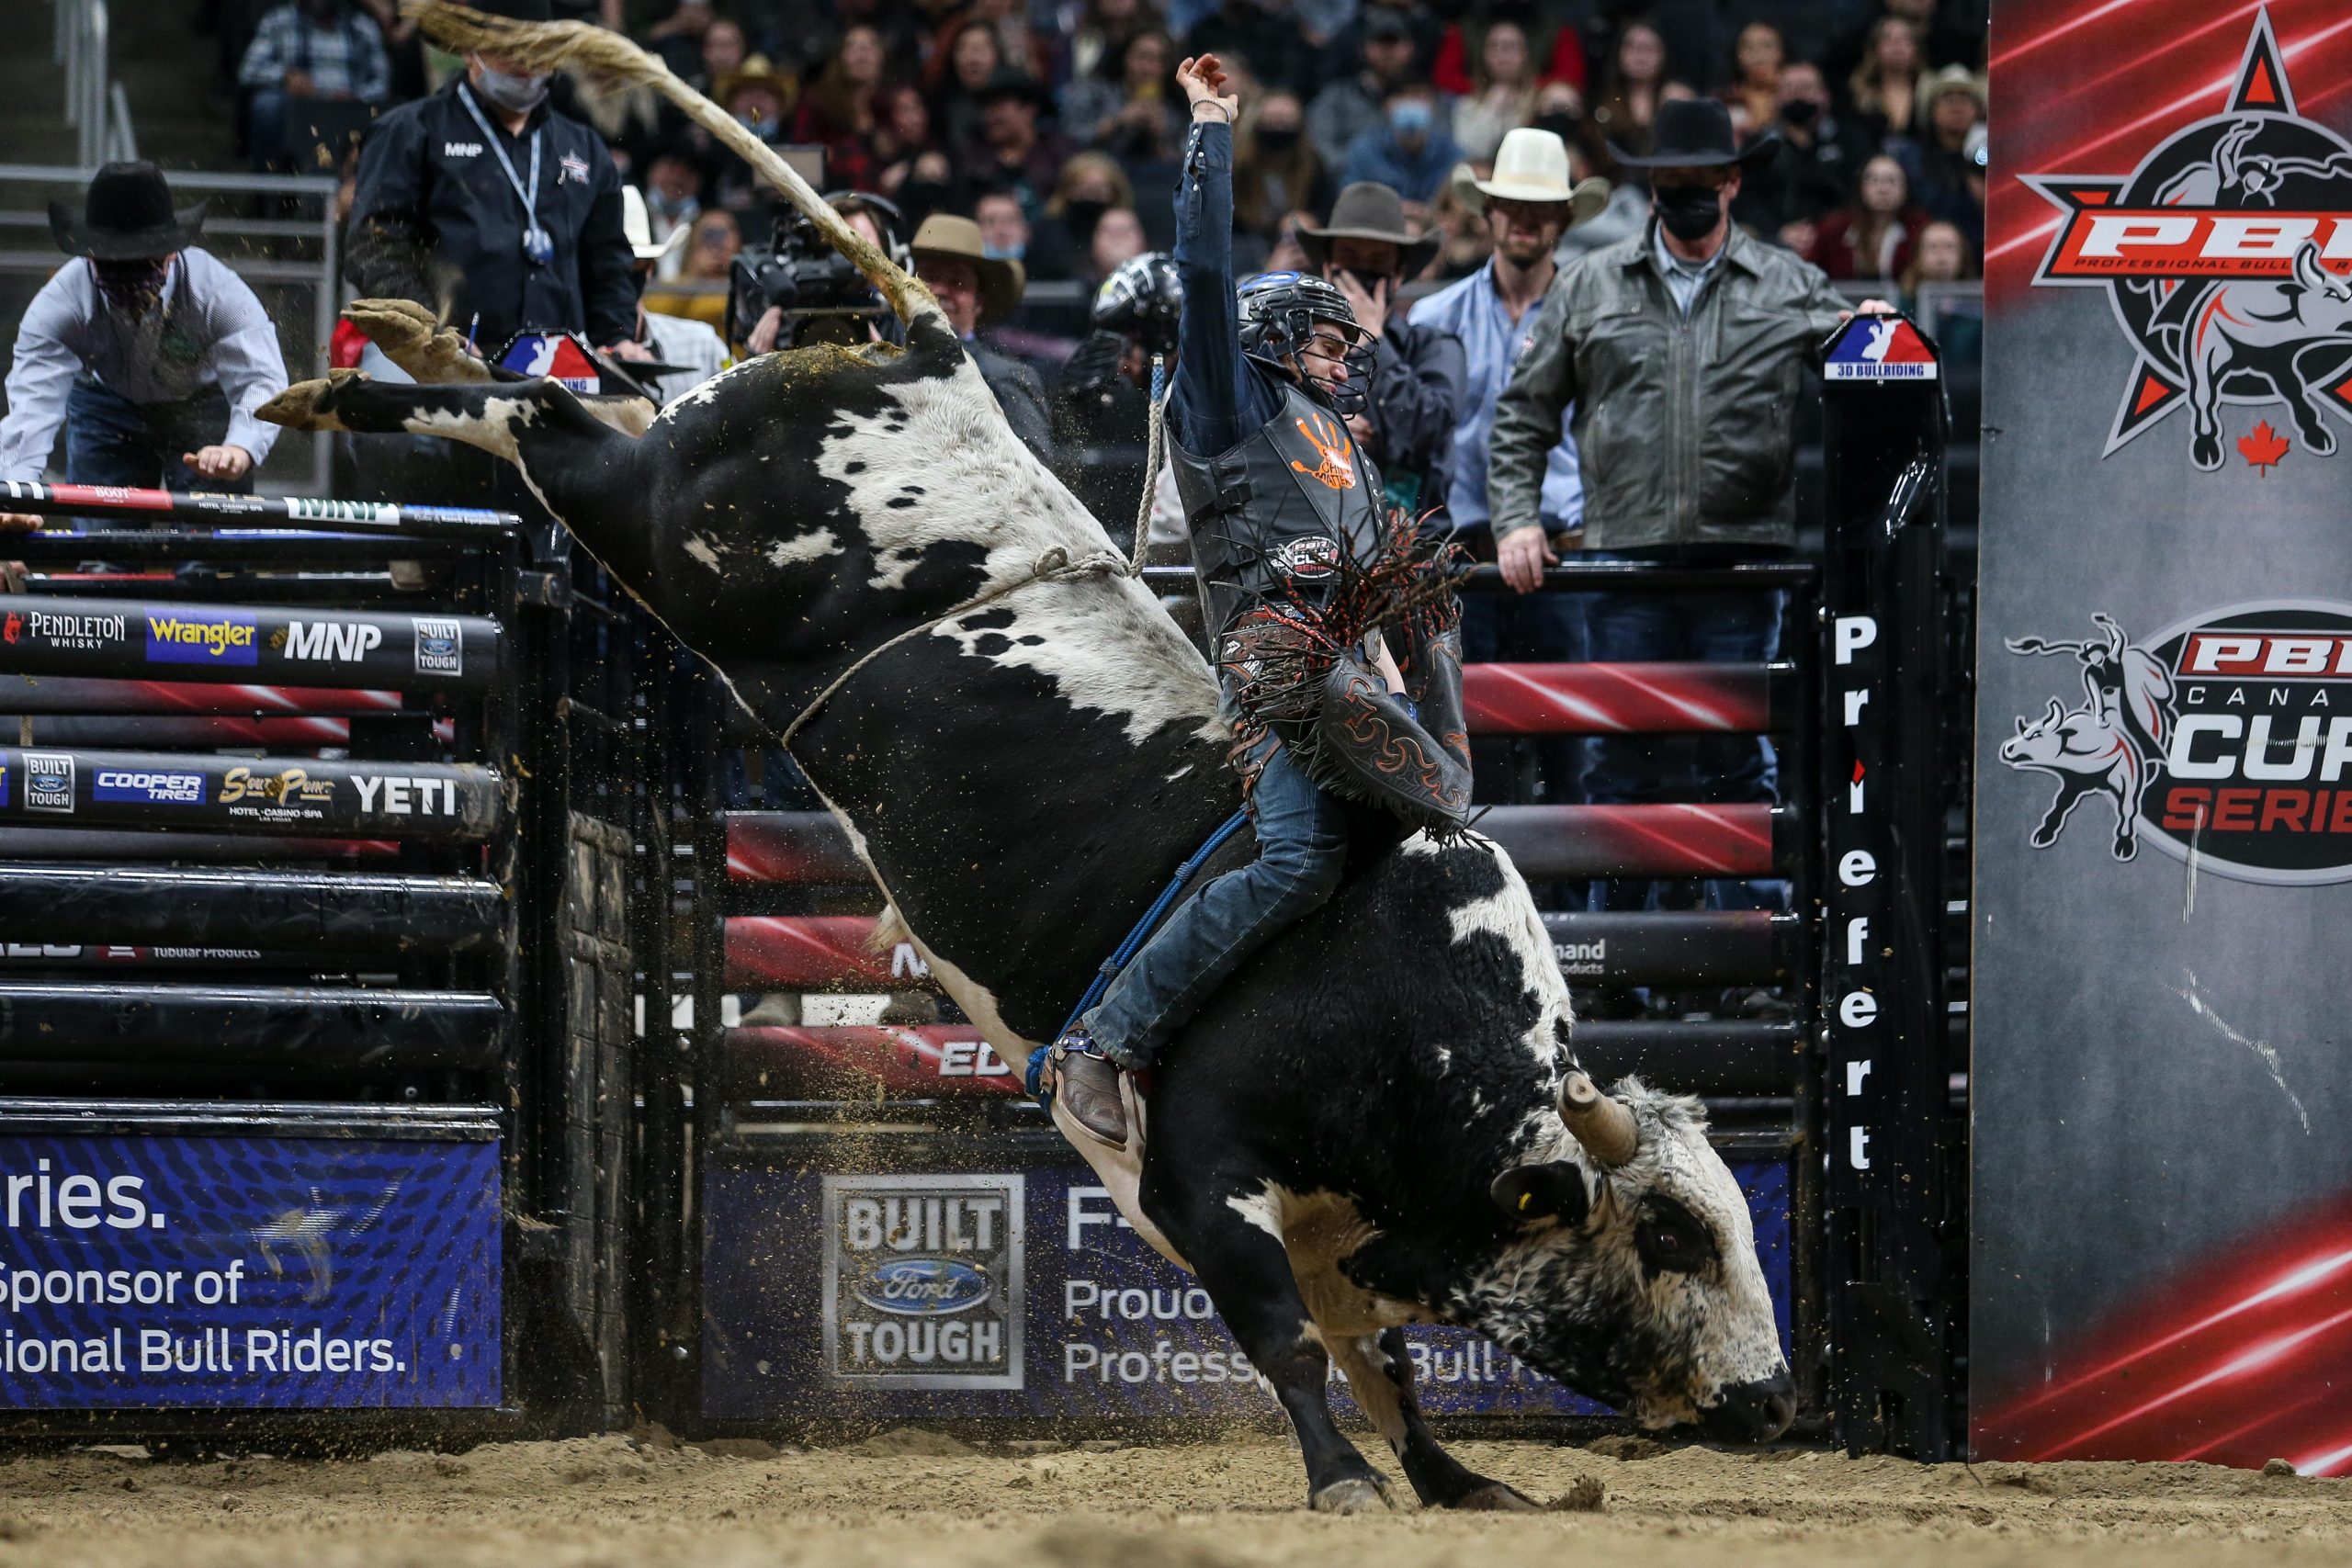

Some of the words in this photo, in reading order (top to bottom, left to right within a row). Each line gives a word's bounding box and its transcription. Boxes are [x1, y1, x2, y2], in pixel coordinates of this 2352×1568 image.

[445, 142, 482, 157] MNP
[2078, 216, 2352, 259] PB
[2074, 259, 2230, 270] PROFESSIONAL
[2240, 260, 2293, 270] BULL
[1838, 365, 1853, 378] 3D
[1857, 365, 1925, 378] BULLRIDING
[29, 611, 126, 641] PENDLETON
[149, 616, 255, 656] Wrangler
[284, 621, 382, 661] MNP
[418, 623, 457, 639] BUILT
[51, 637, 103, 649] WHISKY
[2192, 637, 2352, 673] PB
[420, 655, 458, 669] TOUGH
[2187, 687, 2329, 705] CANA
[29, 759, 70, 775] BUILT
[97, 773, 202, 790] COOPER
[30, 792, 70, 806] TOUGH
[148, 788, 200, 801] TIRES
[350, 774, 456, 816] YETI
[2162, 787, 2352, 833] SERI
[7, 1158, 165, 1229] ries.
[846, 1198, 1001, 1250] BUILT
[0, 1259, 182, 1312] ponsor
[194, 1259, 244, 1304] of
[882, 1266, 962, 1303] Ford
[0, 1329, 125, 1372] ional
[141, 1329, 232, 1372] Bull
[248, 1328, 406, 1372] Riders.
[846, 1321, 1000, 1363] TOUGH
